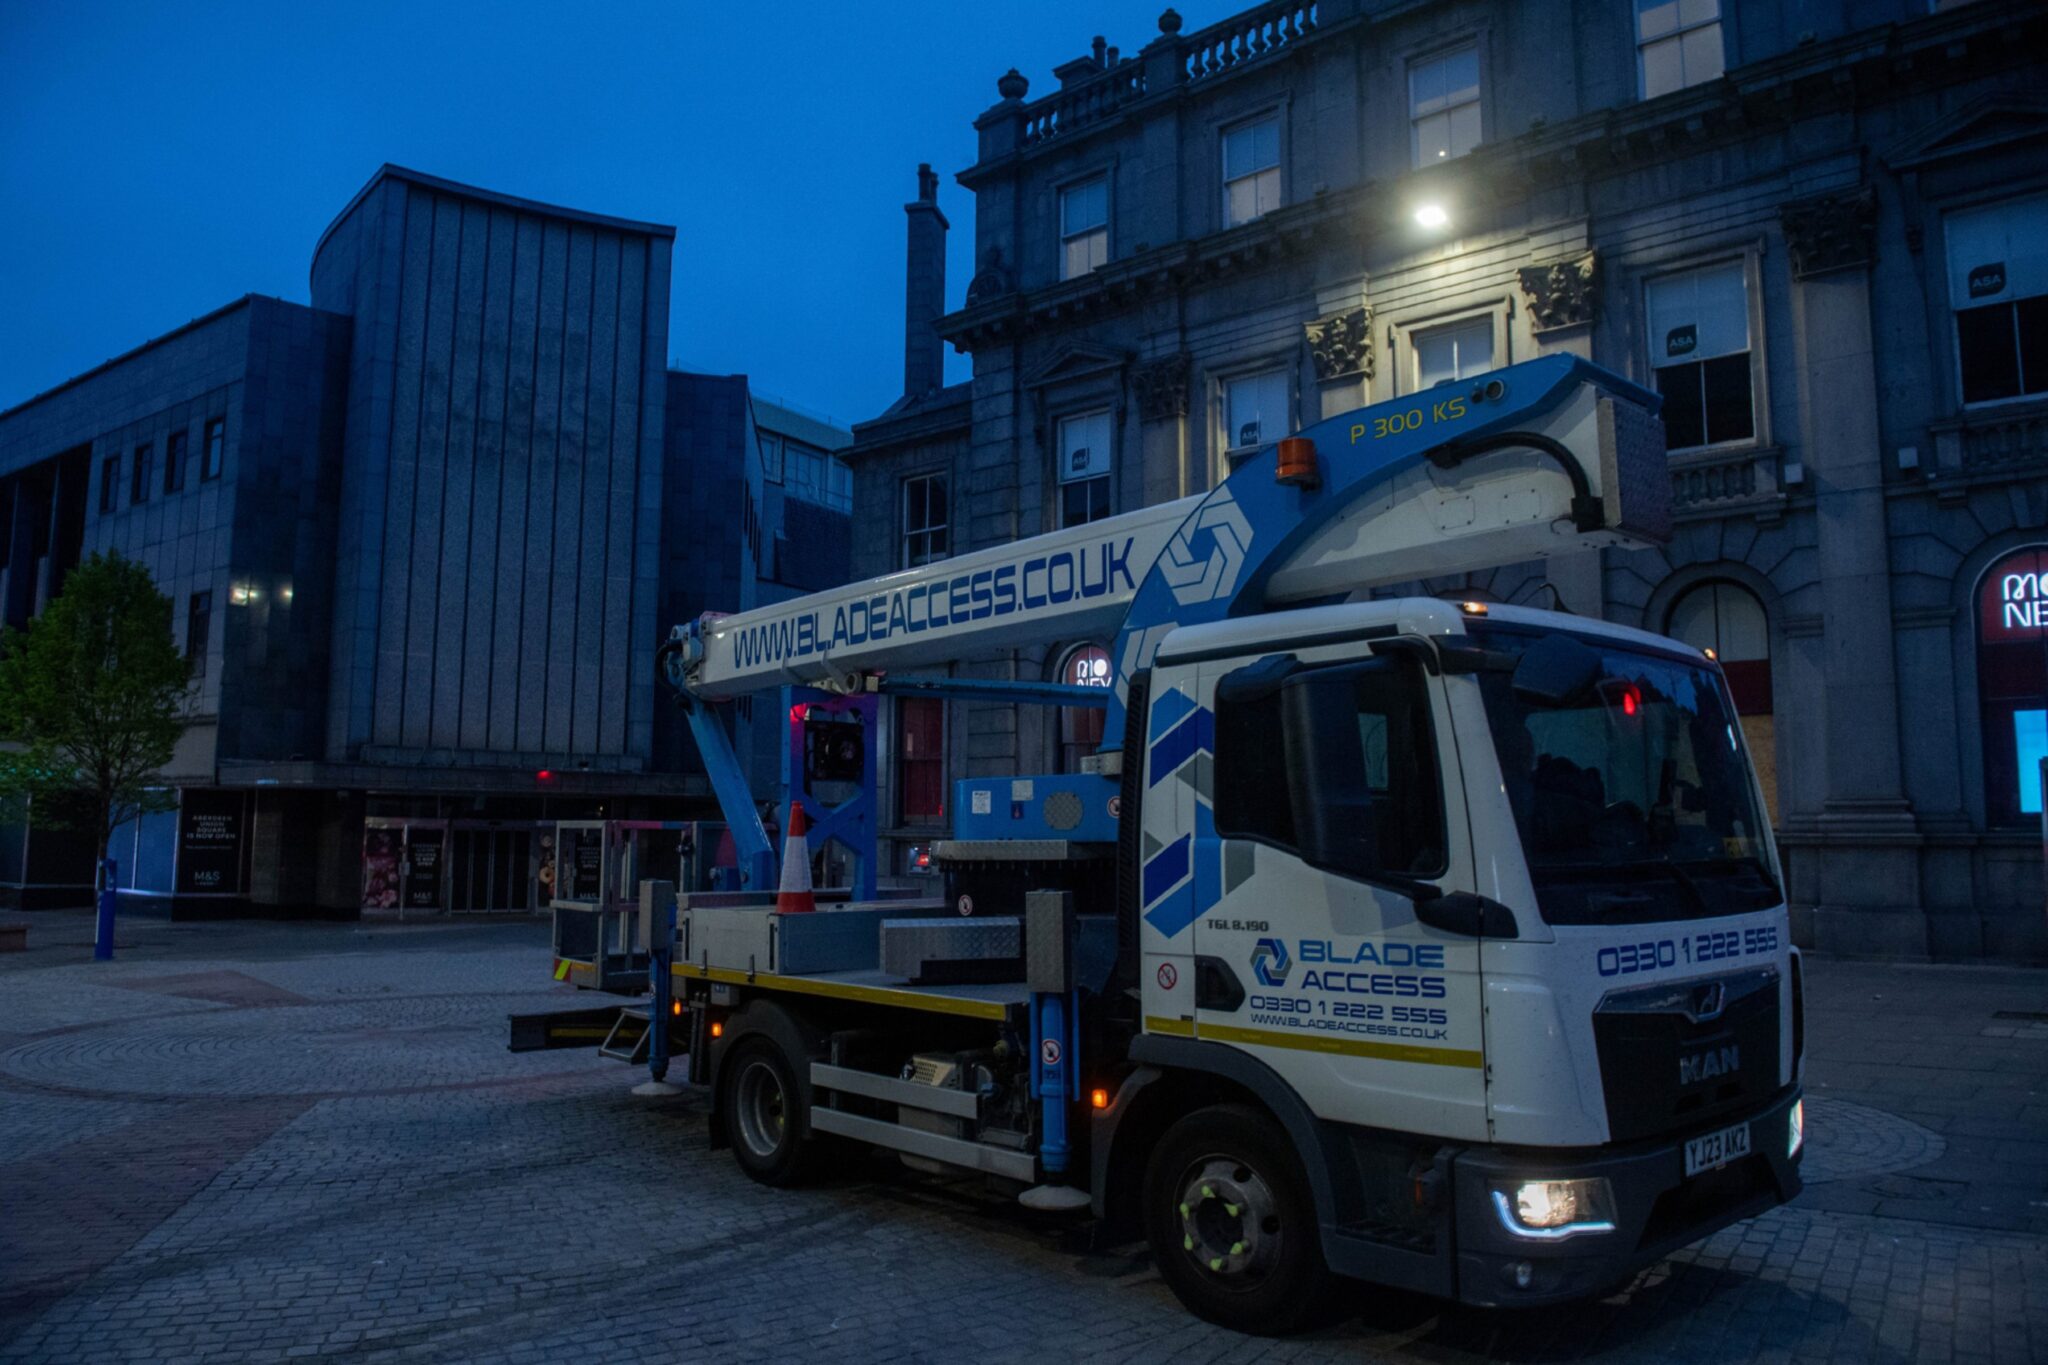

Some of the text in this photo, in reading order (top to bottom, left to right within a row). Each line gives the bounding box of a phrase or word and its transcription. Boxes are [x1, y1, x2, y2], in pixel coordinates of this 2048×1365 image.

[1351, 397, 1466, 445] P 300 KS
[734, 537, 1135, 668] WWW.BLADEACCESS.CO.UK
[194, 870, 221, 880] M&S
[1207, 919, 1269, 932] TGL 8.190
[1299, 940, 1444, 968] BLADE
[1598, 926, 1778, 976] 0330 1 222 555
[1301, 970, 1446, 998] ACCESS
[1250, 995, 1447, 1024] 0330 1 222 555
[1251, 1013, 1448, 1041] WWW.BLADEACCESS.CO.UK
[1679, 1044, 1740, 1086] MAN
[1689, 1127, 1746, 1169] YJ23 AKZ
